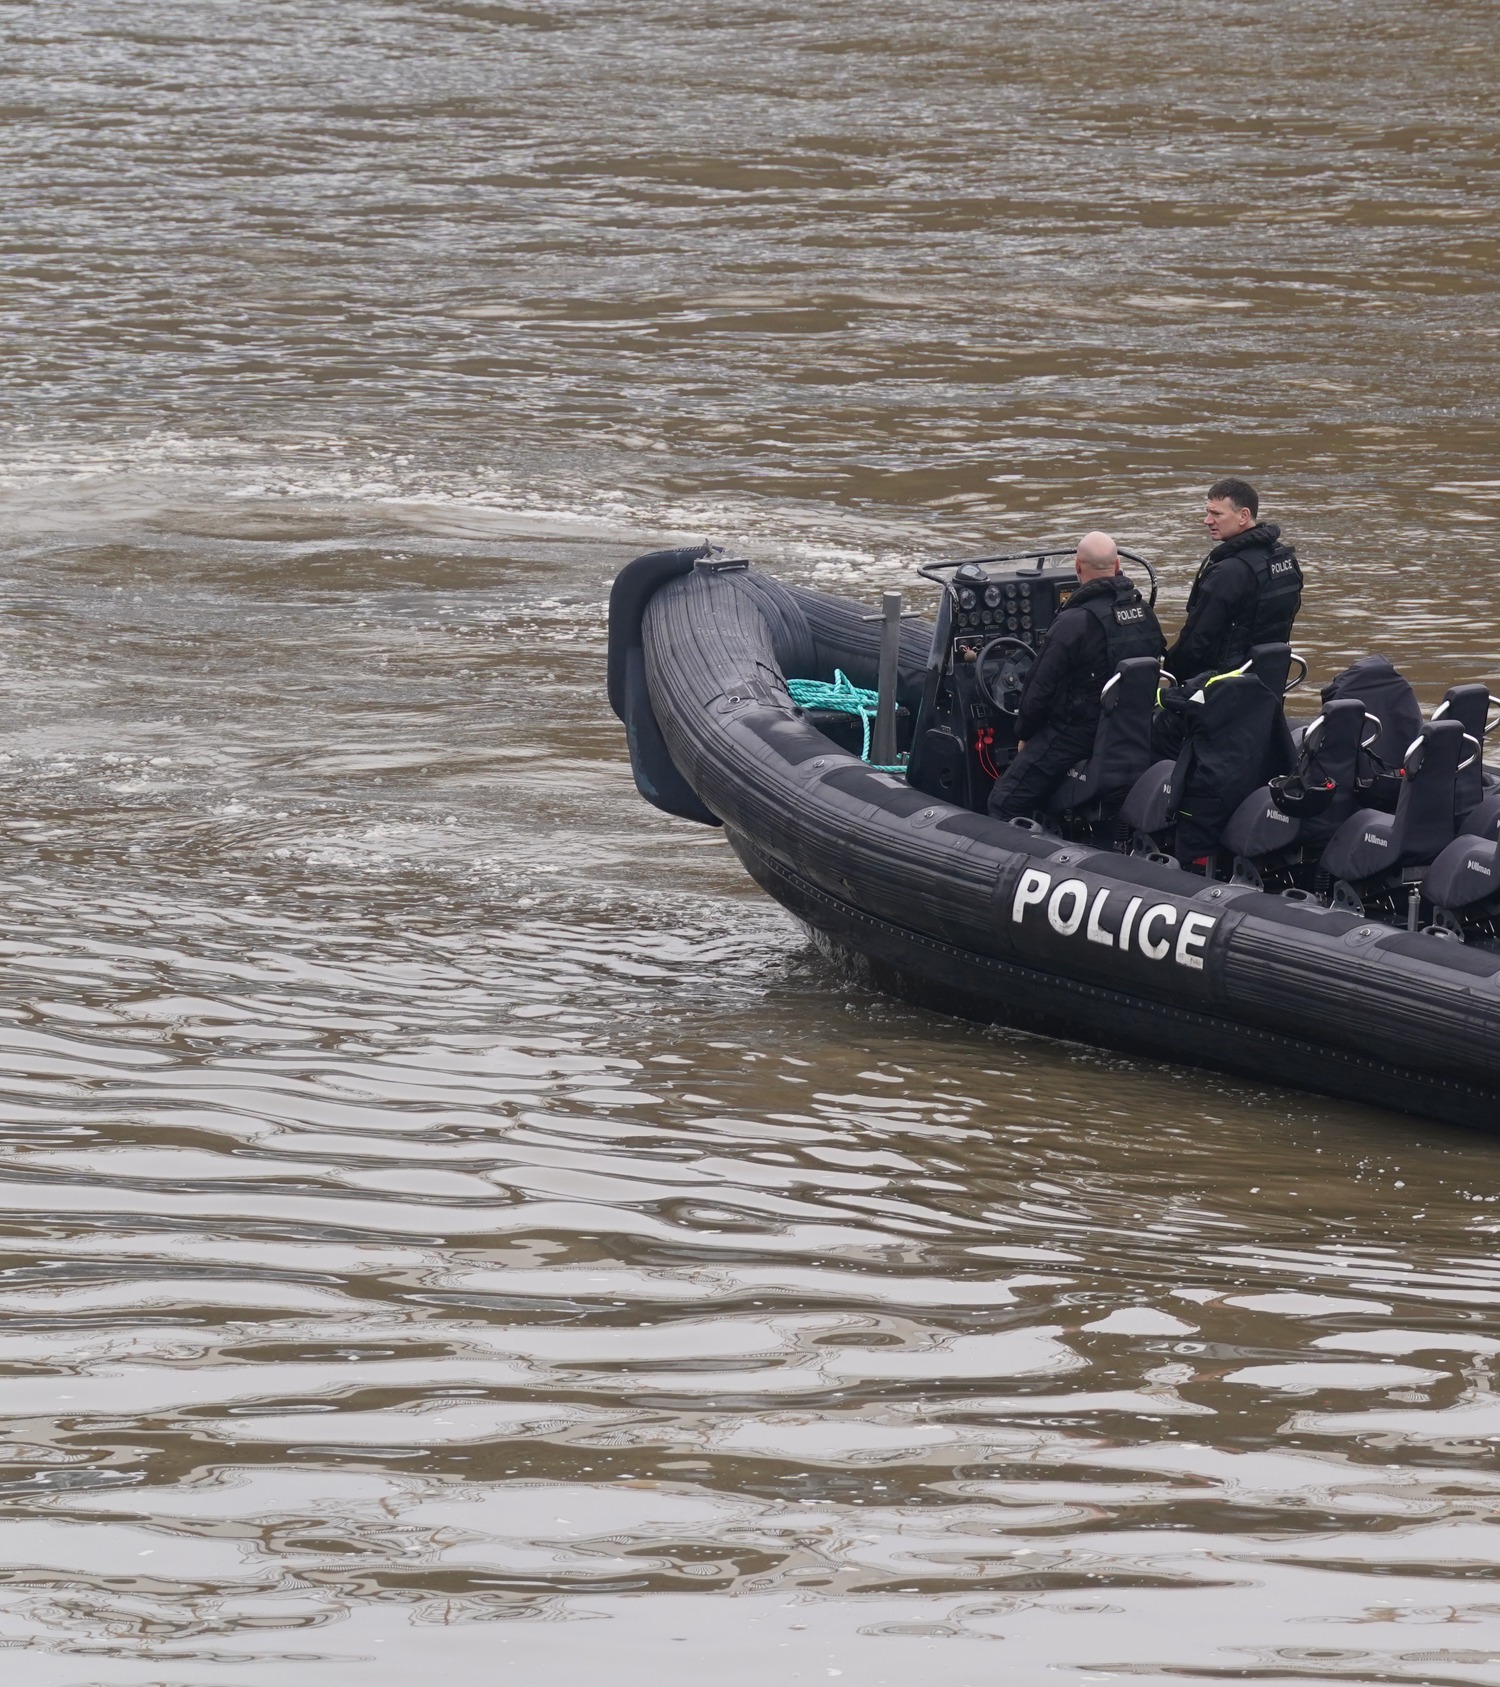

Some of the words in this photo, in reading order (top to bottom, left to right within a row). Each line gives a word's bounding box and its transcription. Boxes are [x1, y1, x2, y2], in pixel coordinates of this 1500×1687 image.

[1271, 559, 1293, 574] POLICE
[1117, 607, 1144, 621] POLICE
[1270, 810, 1290, 824] Ullman
[1368, 833, 1388, 848] Ullman
[1471, 861, 1492, 876] Ullman
[1012, 868, 1217, 970] POLICE
